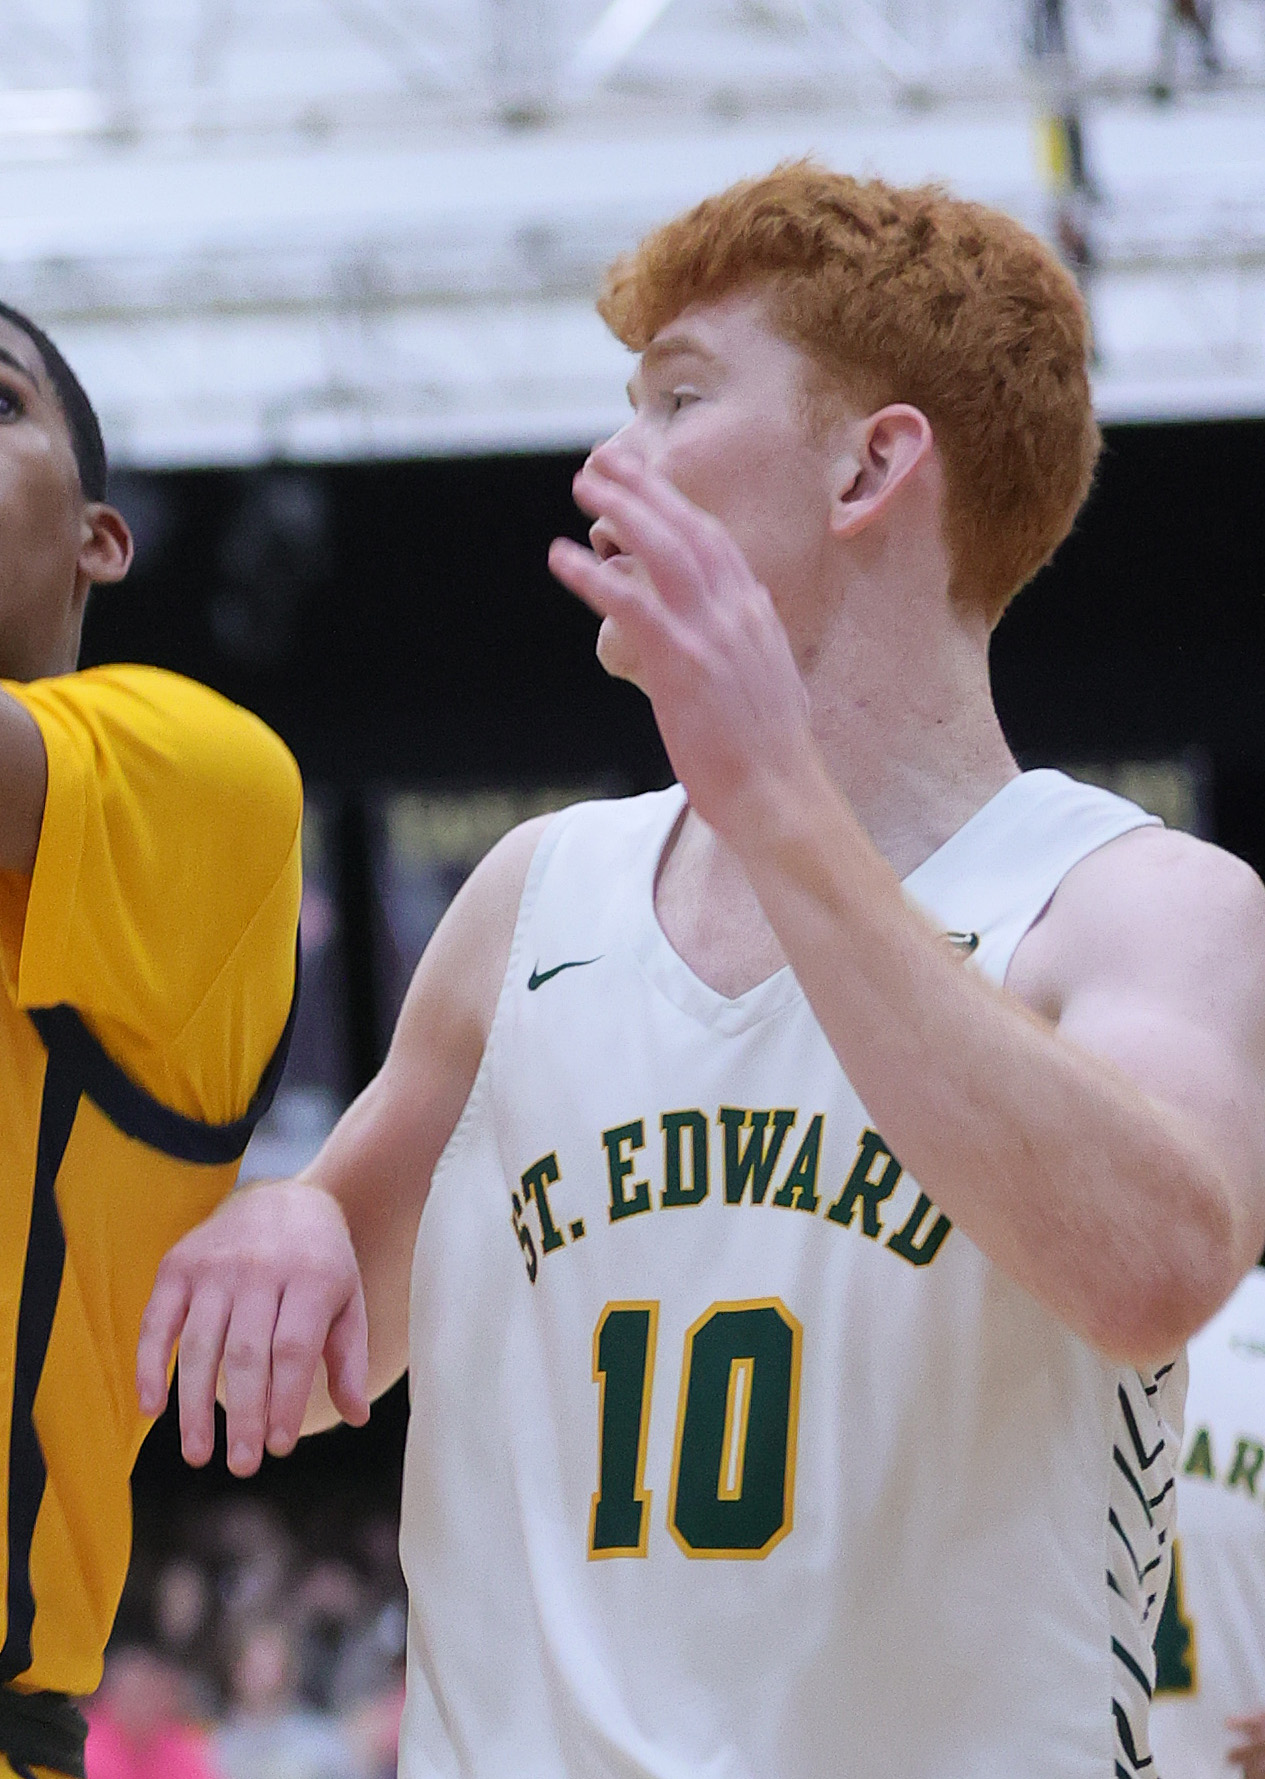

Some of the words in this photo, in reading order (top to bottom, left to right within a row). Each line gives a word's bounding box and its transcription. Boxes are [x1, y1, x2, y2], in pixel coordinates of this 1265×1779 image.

[511, 1150, 586, 1286] ST.
[601, 1104, 953, 1269] EDWARD
[587, 1296, 805, 1561] 10
